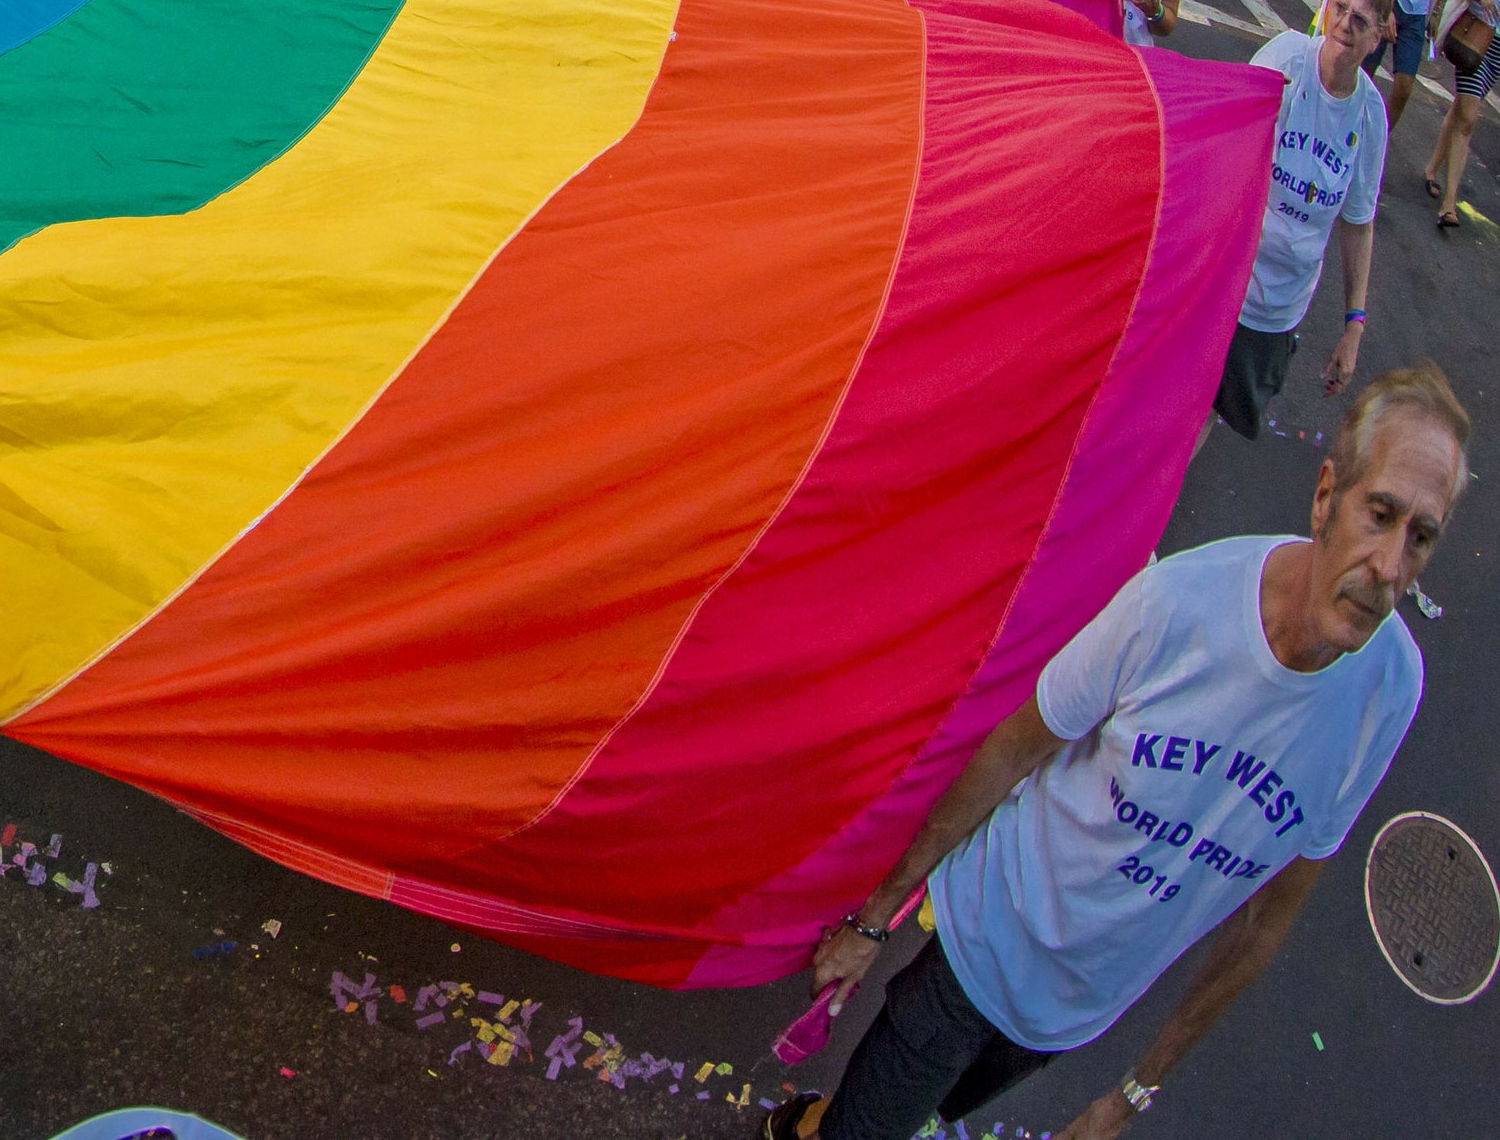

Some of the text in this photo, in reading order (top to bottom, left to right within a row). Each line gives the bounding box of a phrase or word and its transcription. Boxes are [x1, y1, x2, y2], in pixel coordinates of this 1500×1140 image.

[1278, 131, 1349, 179] KEY WEST
[1272, 163, 1306, 195] ORLD
[1278, 202, 1309, 222] 2019
[1131, 733, 1304, 838] KEY WEST
[1109, 776, 1270, 880] WORLD PRIDE
[1116, 856, 1181, 902] 2019
